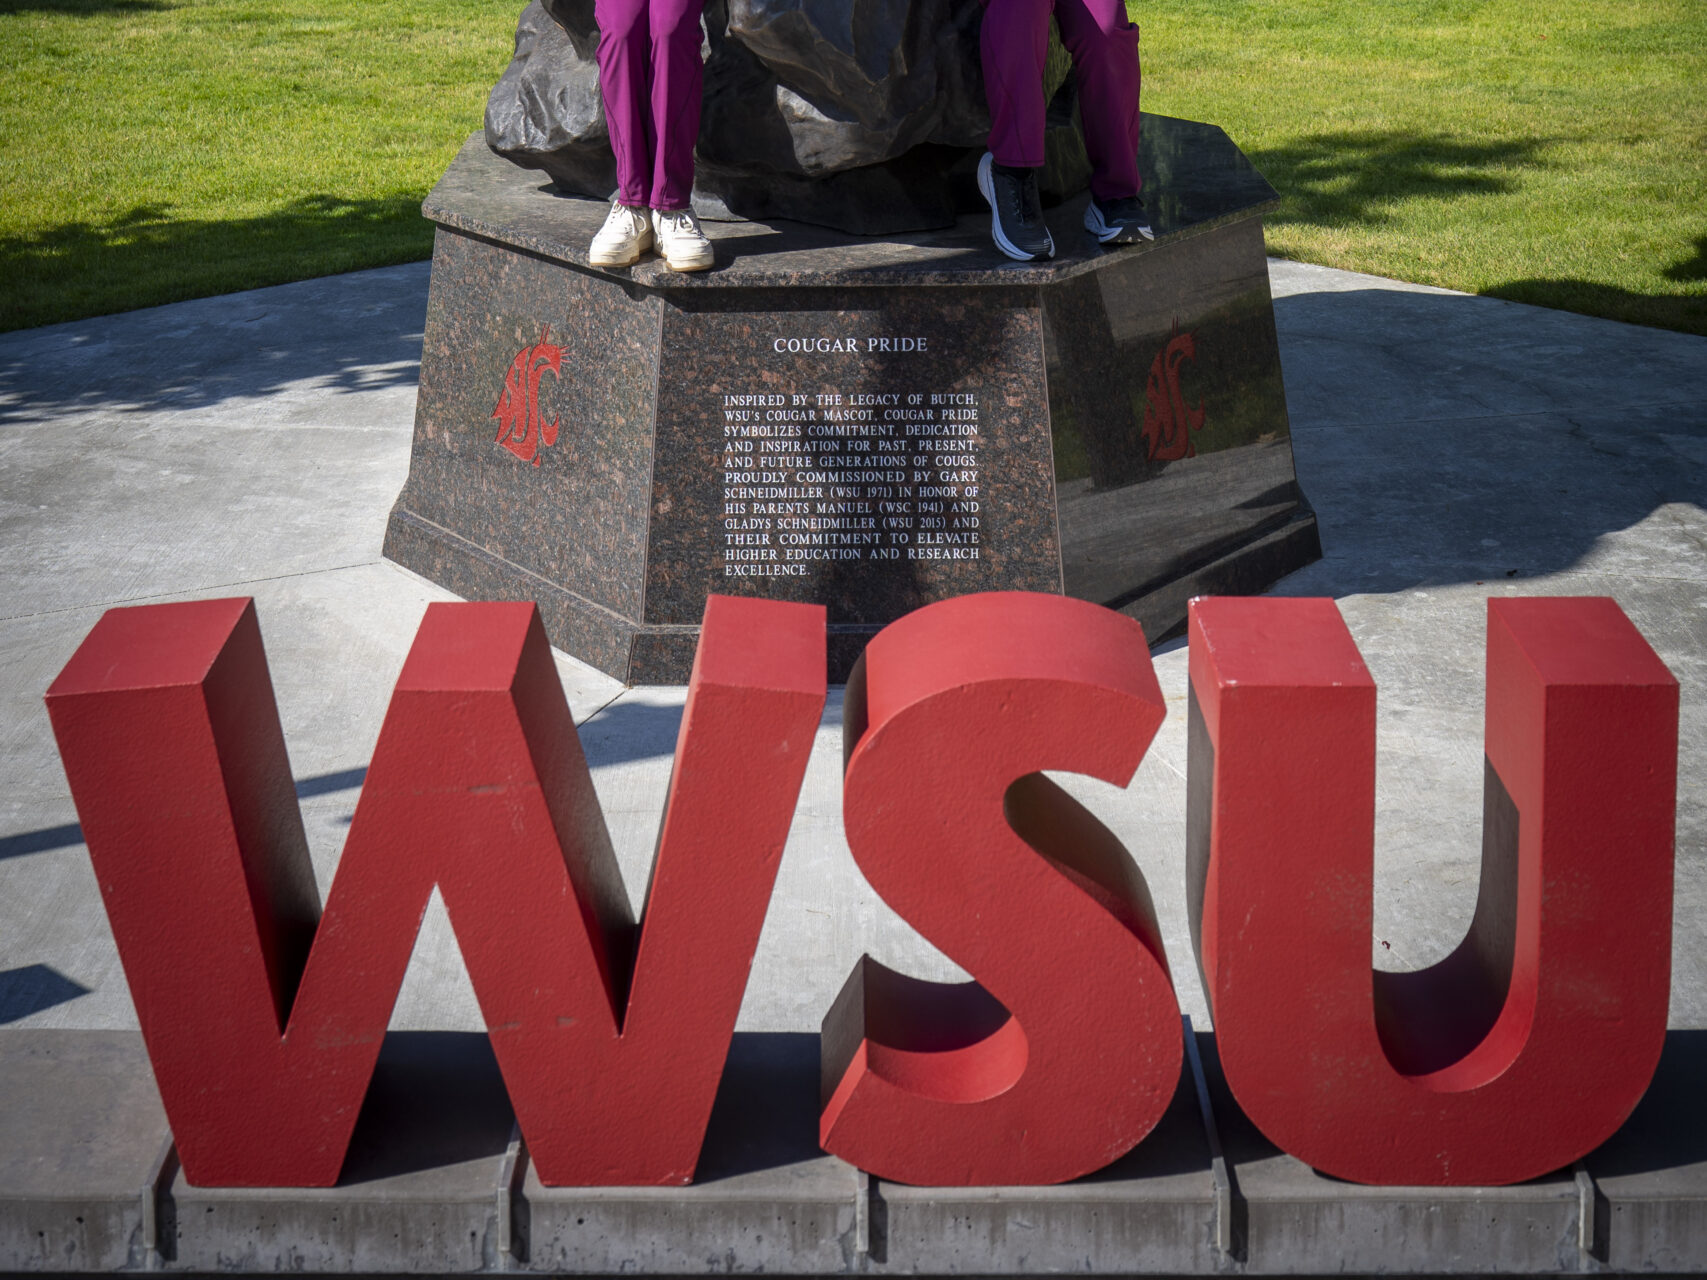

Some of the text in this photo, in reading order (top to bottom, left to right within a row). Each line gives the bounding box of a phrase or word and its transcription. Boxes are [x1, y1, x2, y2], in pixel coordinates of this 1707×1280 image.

[773, 337, 928, 354] COUGAR PRIDE
[724, 393, 979, 407] INSPIRED BY THE LEGACY OF BUTCH,
[766, 409, 817, 422] COUGAR
[823, 409, 878, 422] MASCOT,
[884, 409, 935, 421] COUGAR
[941, 408, 979, 421] PRIDE
[724, 424, 979, 437] SYMBOLIZES COMMITMENT, DEDICATION
[724, 439, 980, 453] AND INSPIRATION FOR PAST, PRESENT,
[724, 456, 754, 468] AND
[759, 456, 813, 468] FUTURE
[819, 455, 907, 467] GENERATIONS
[913, 455, 929, 467] OF
[724, 470, 979, 484] PROUDLY COMMISSIONED BY GARY
[724, 485, 980, 499] SCHNEIDMILLER (WSU 1971) IN HONOR OF
[724, 501, 980, 515] HIS PARENTS MANUEL (WSC 1941) AND
[724, 516, 980, 530] GLADYS SCHNEIDMILLER (WSU 2015) AND
[724, 532, 980, 545] THEIR COMMITMENT TO ELEVATE
[724, 547, 980, 561] HIGHER EDUCATION AND RESEARCH
[725, 564, 811, 577] EXCELLENCE.
[45, 593, 1680, 1187] WSU
